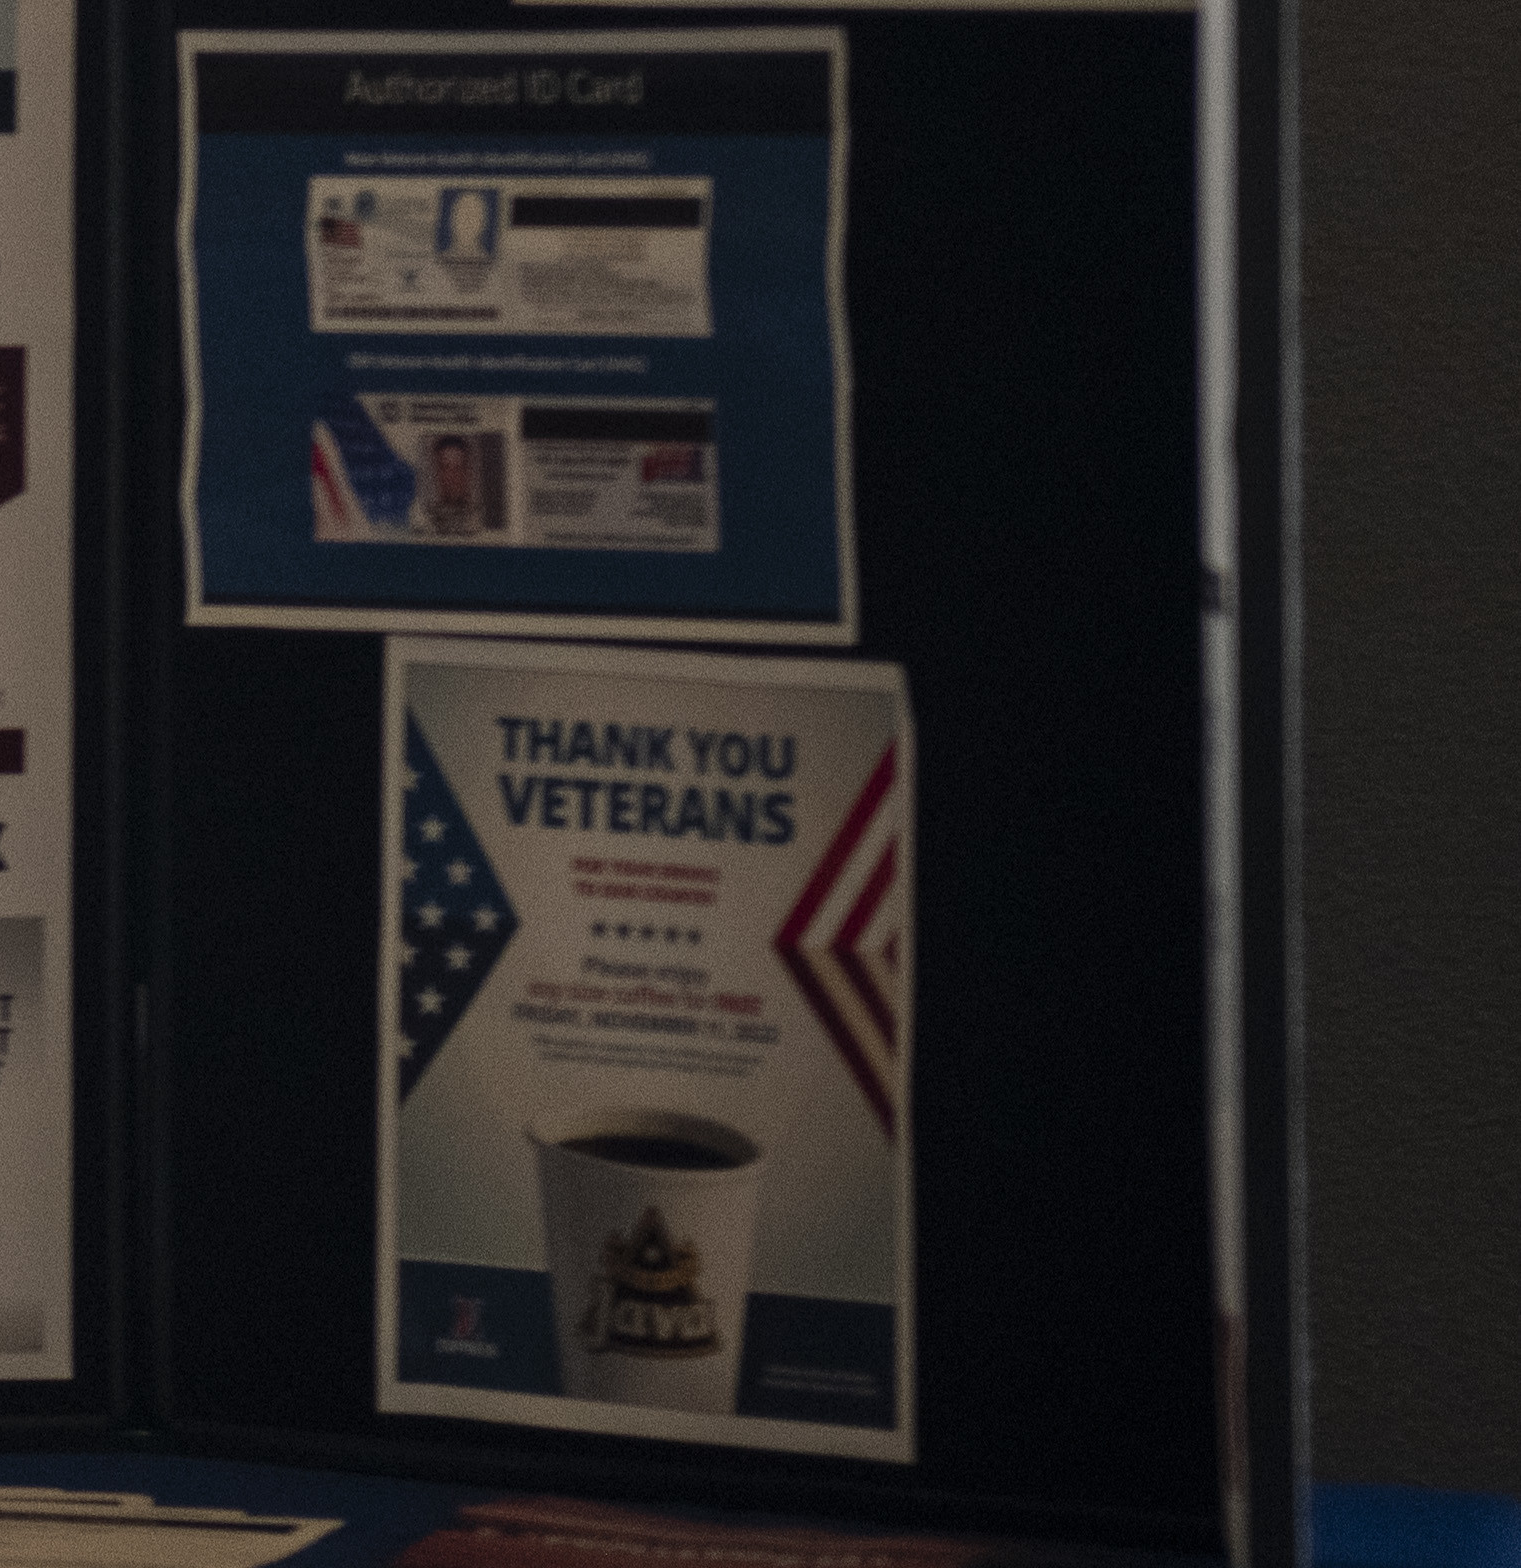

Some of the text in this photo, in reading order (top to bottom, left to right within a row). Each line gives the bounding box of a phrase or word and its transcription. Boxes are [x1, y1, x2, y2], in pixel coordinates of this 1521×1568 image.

[496, 716, 797, 780] THANK YOU
[496, 773, 796, 845] VETERANS
